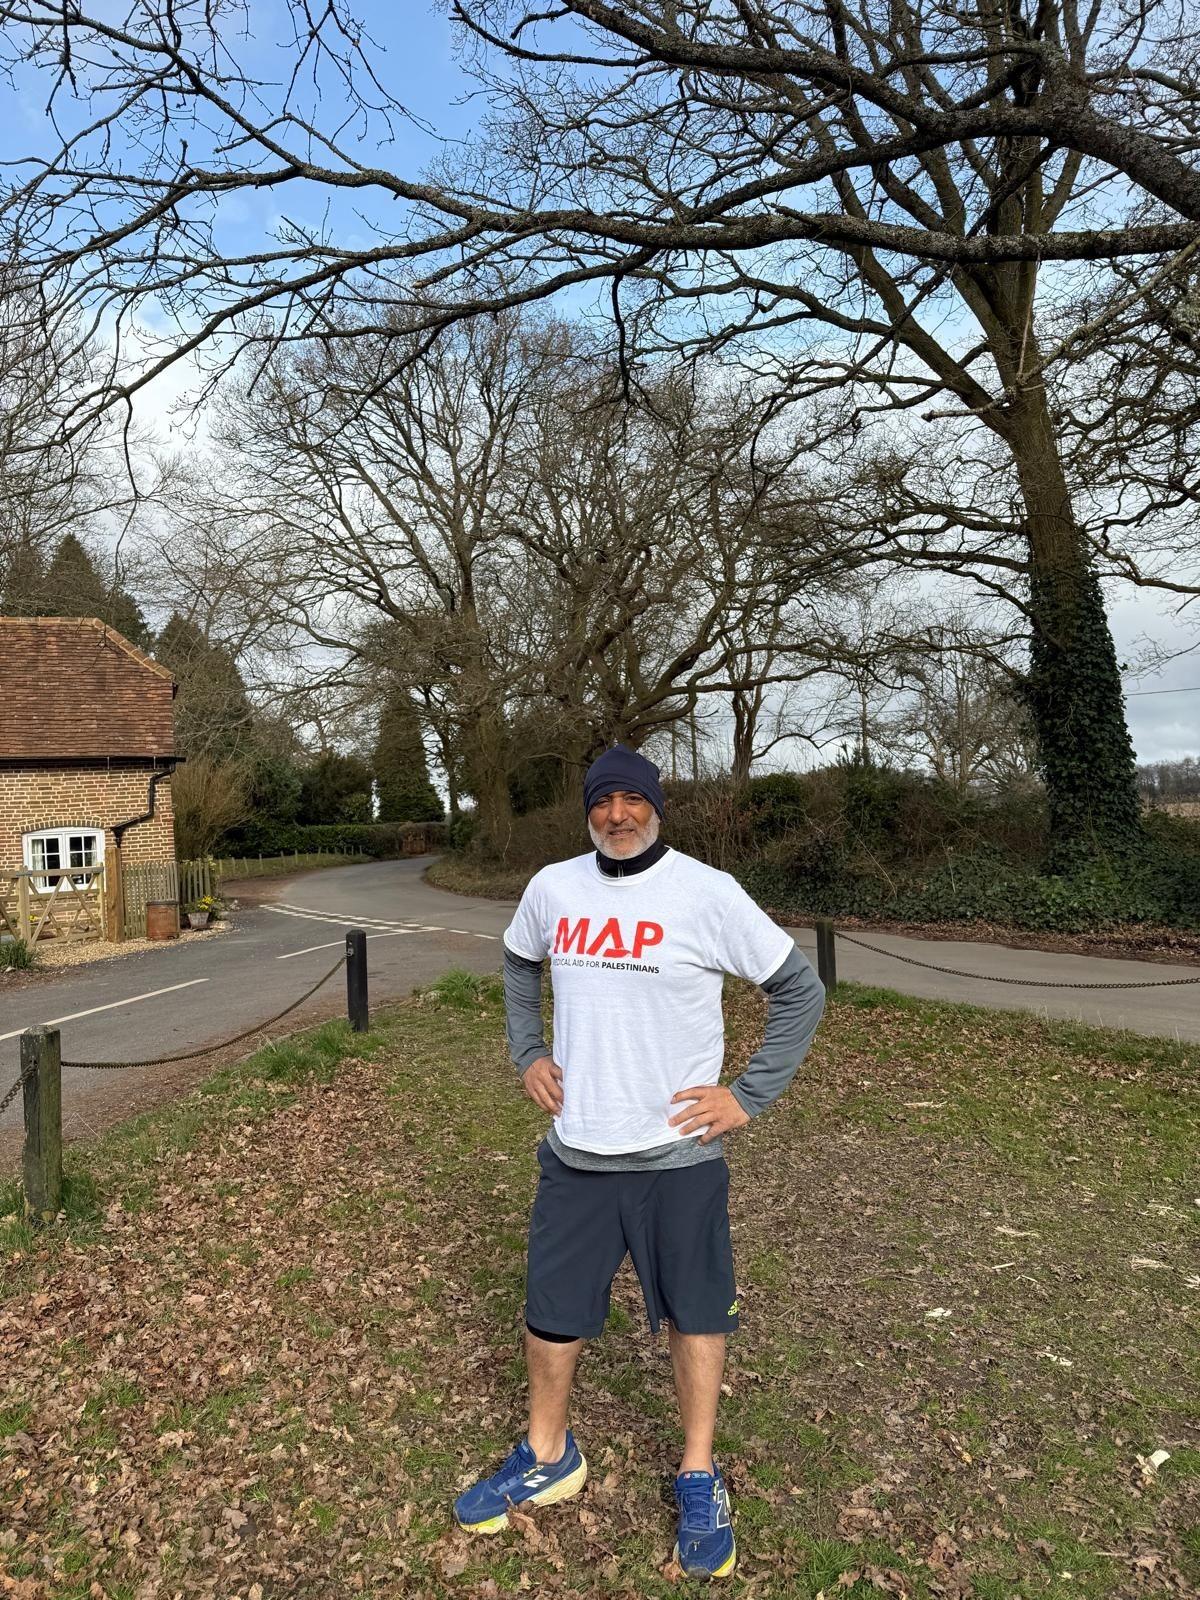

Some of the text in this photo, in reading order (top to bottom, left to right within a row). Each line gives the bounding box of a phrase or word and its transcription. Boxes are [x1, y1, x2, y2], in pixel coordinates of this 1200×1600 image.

[553, 917, 664, 958] MAP
[572, 959, 584, 967] AID
[586, 960, 600, 968] FOR
[601, 961, 660, 974] PALESTINIANS
